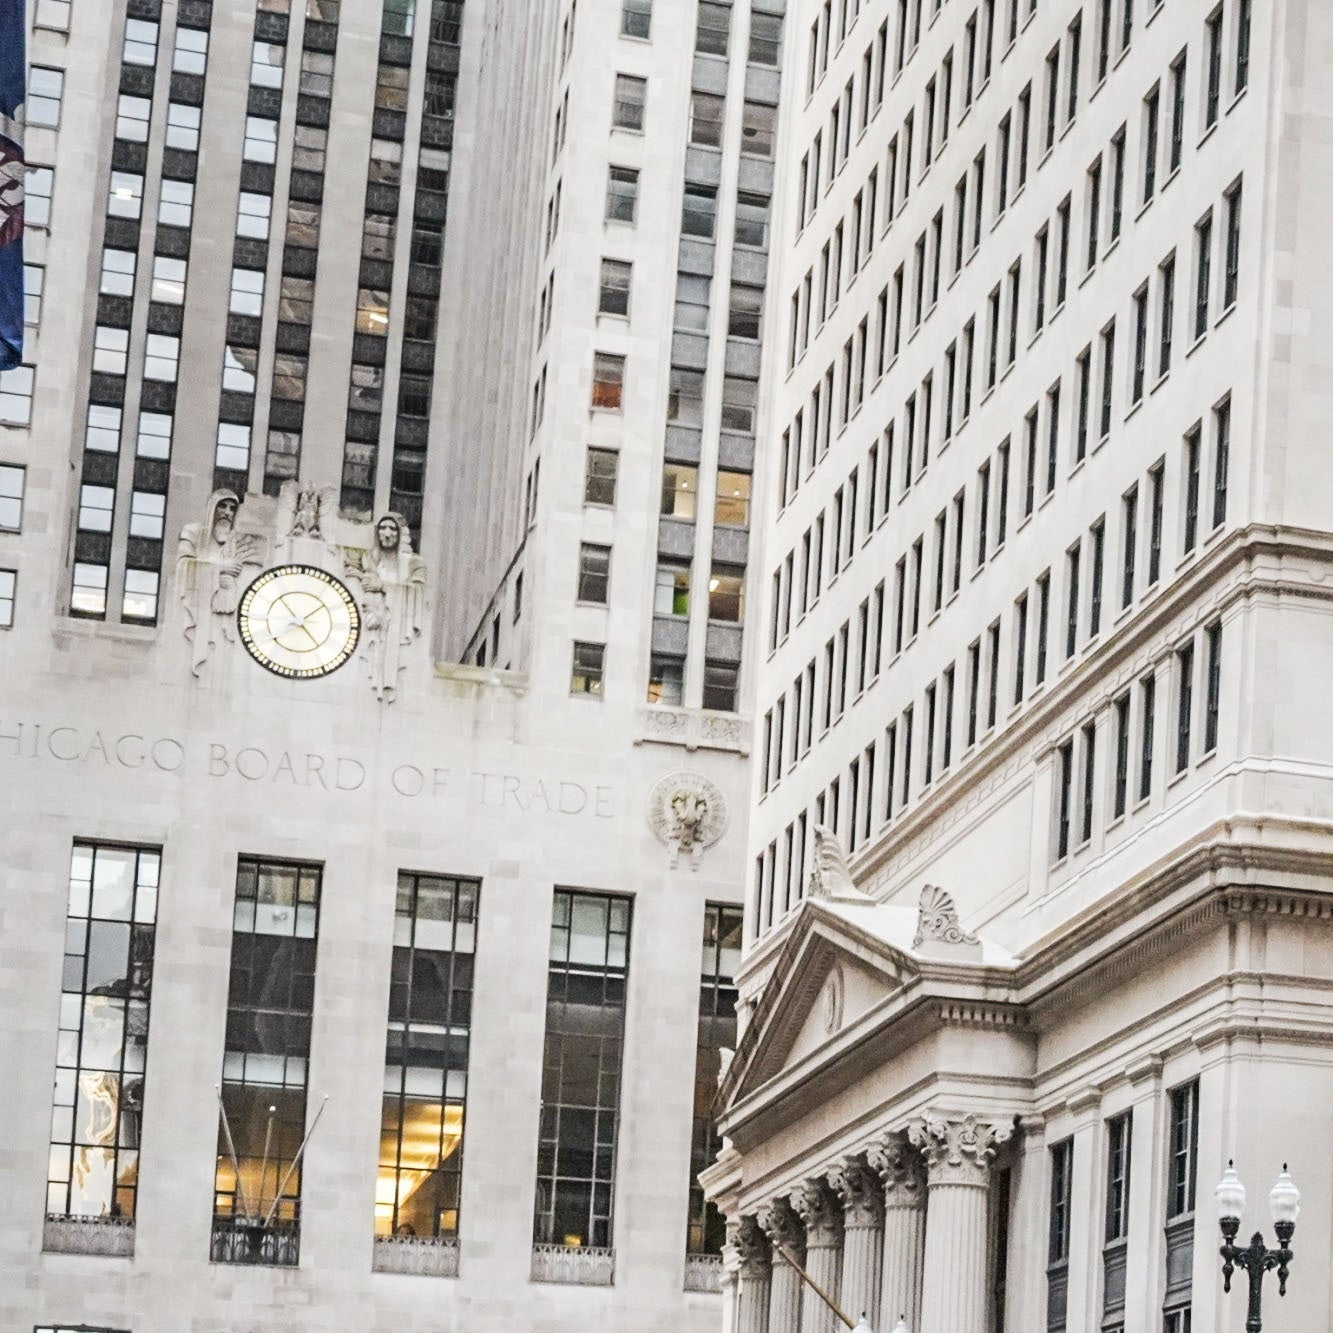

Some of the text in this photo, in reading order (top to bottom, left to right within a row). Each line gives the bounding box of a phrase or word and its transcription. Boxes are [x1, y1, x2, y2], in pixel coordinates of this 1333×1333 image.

[207, 743, 367, 791] BOARD
[391, 764, 451, 798] OF
[471, 771, 616, 819] TRADE
